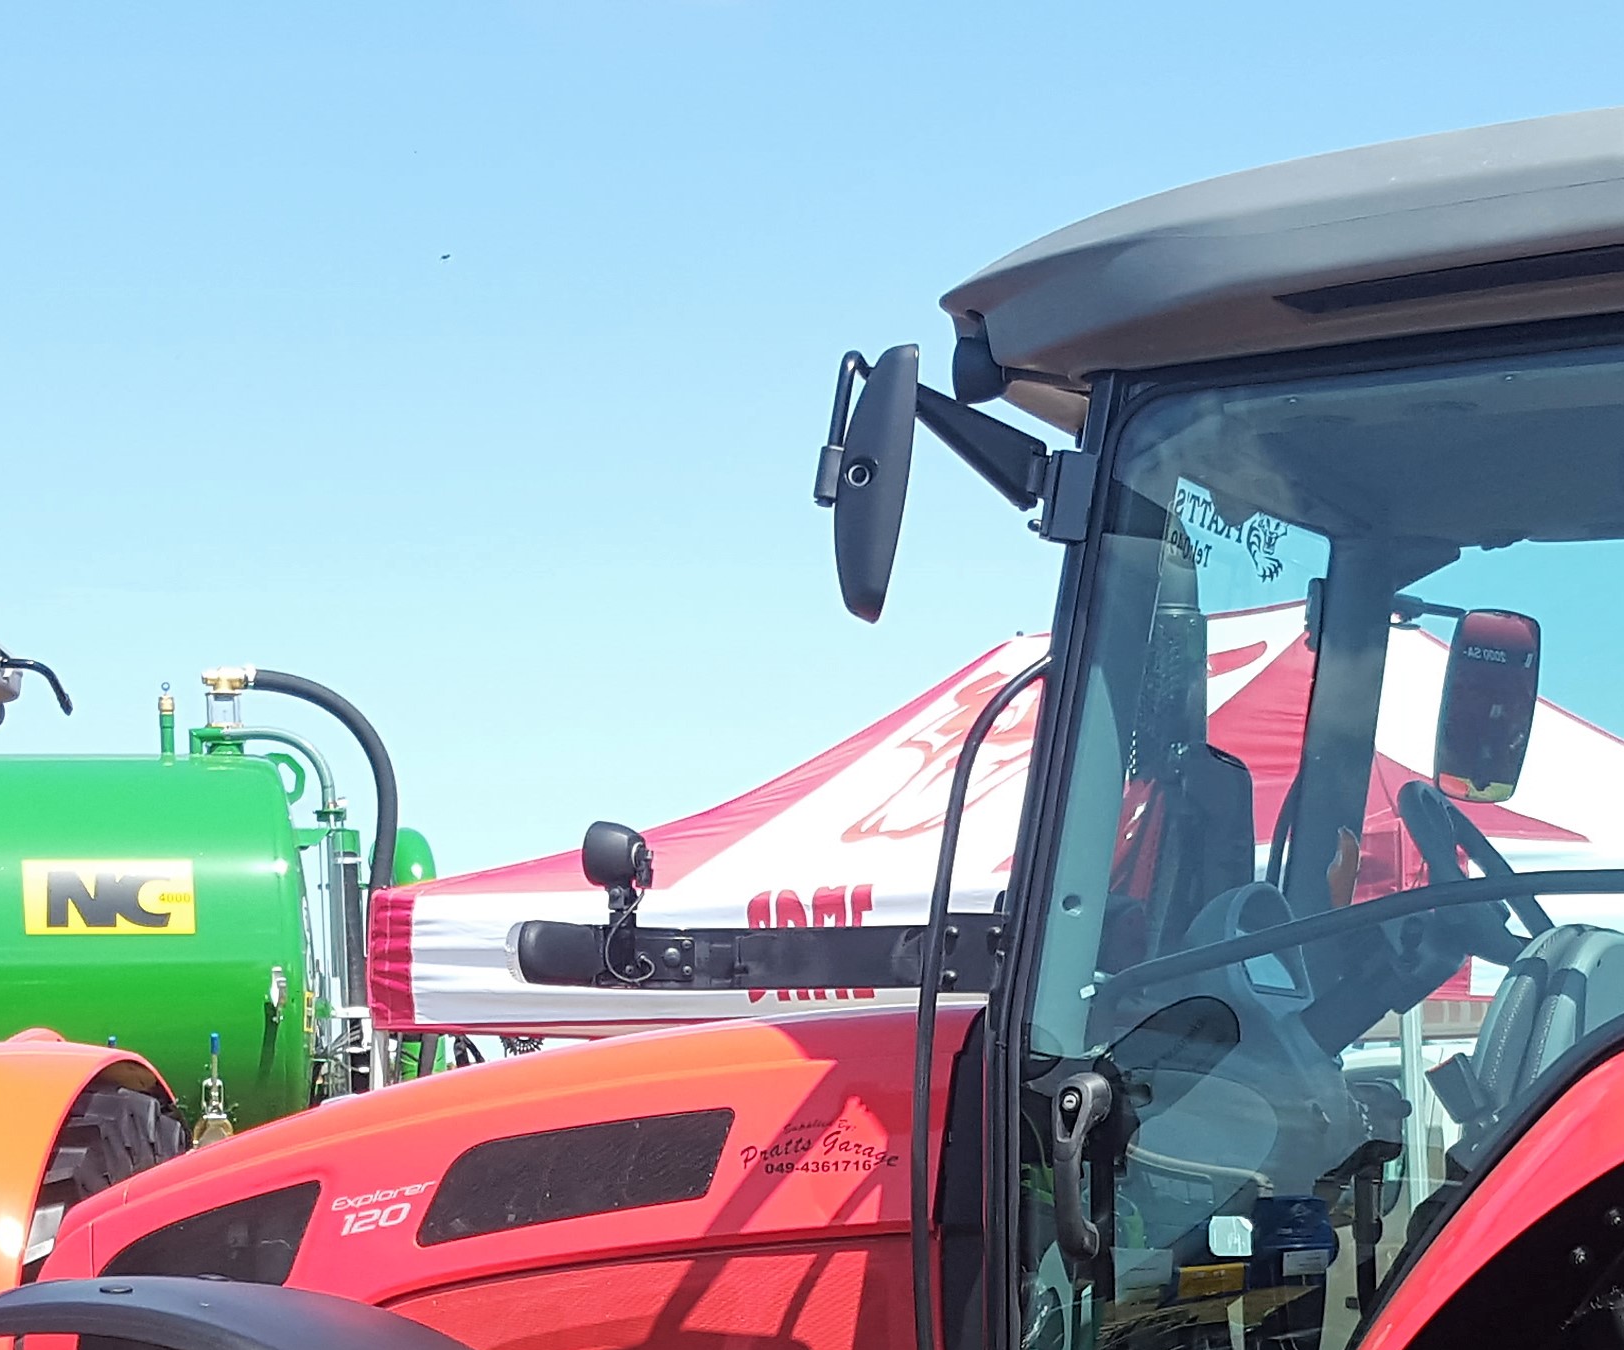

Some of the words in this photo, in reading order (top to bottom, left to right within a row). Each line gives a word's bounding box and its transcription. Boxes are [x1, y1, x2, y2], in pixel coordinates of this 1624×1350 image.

[46, 871, 172, 928] NC
[158, 892, 192, 904] 4000
[739, 1136, 814, 1170] Pratts
[822, 1130, 900, 1168] Garage
[764, 1160, 873, 1175] 049-4361716
[331, 1180, 437, 1212] Explorer
[340, 1202, 412, 1237] 120
